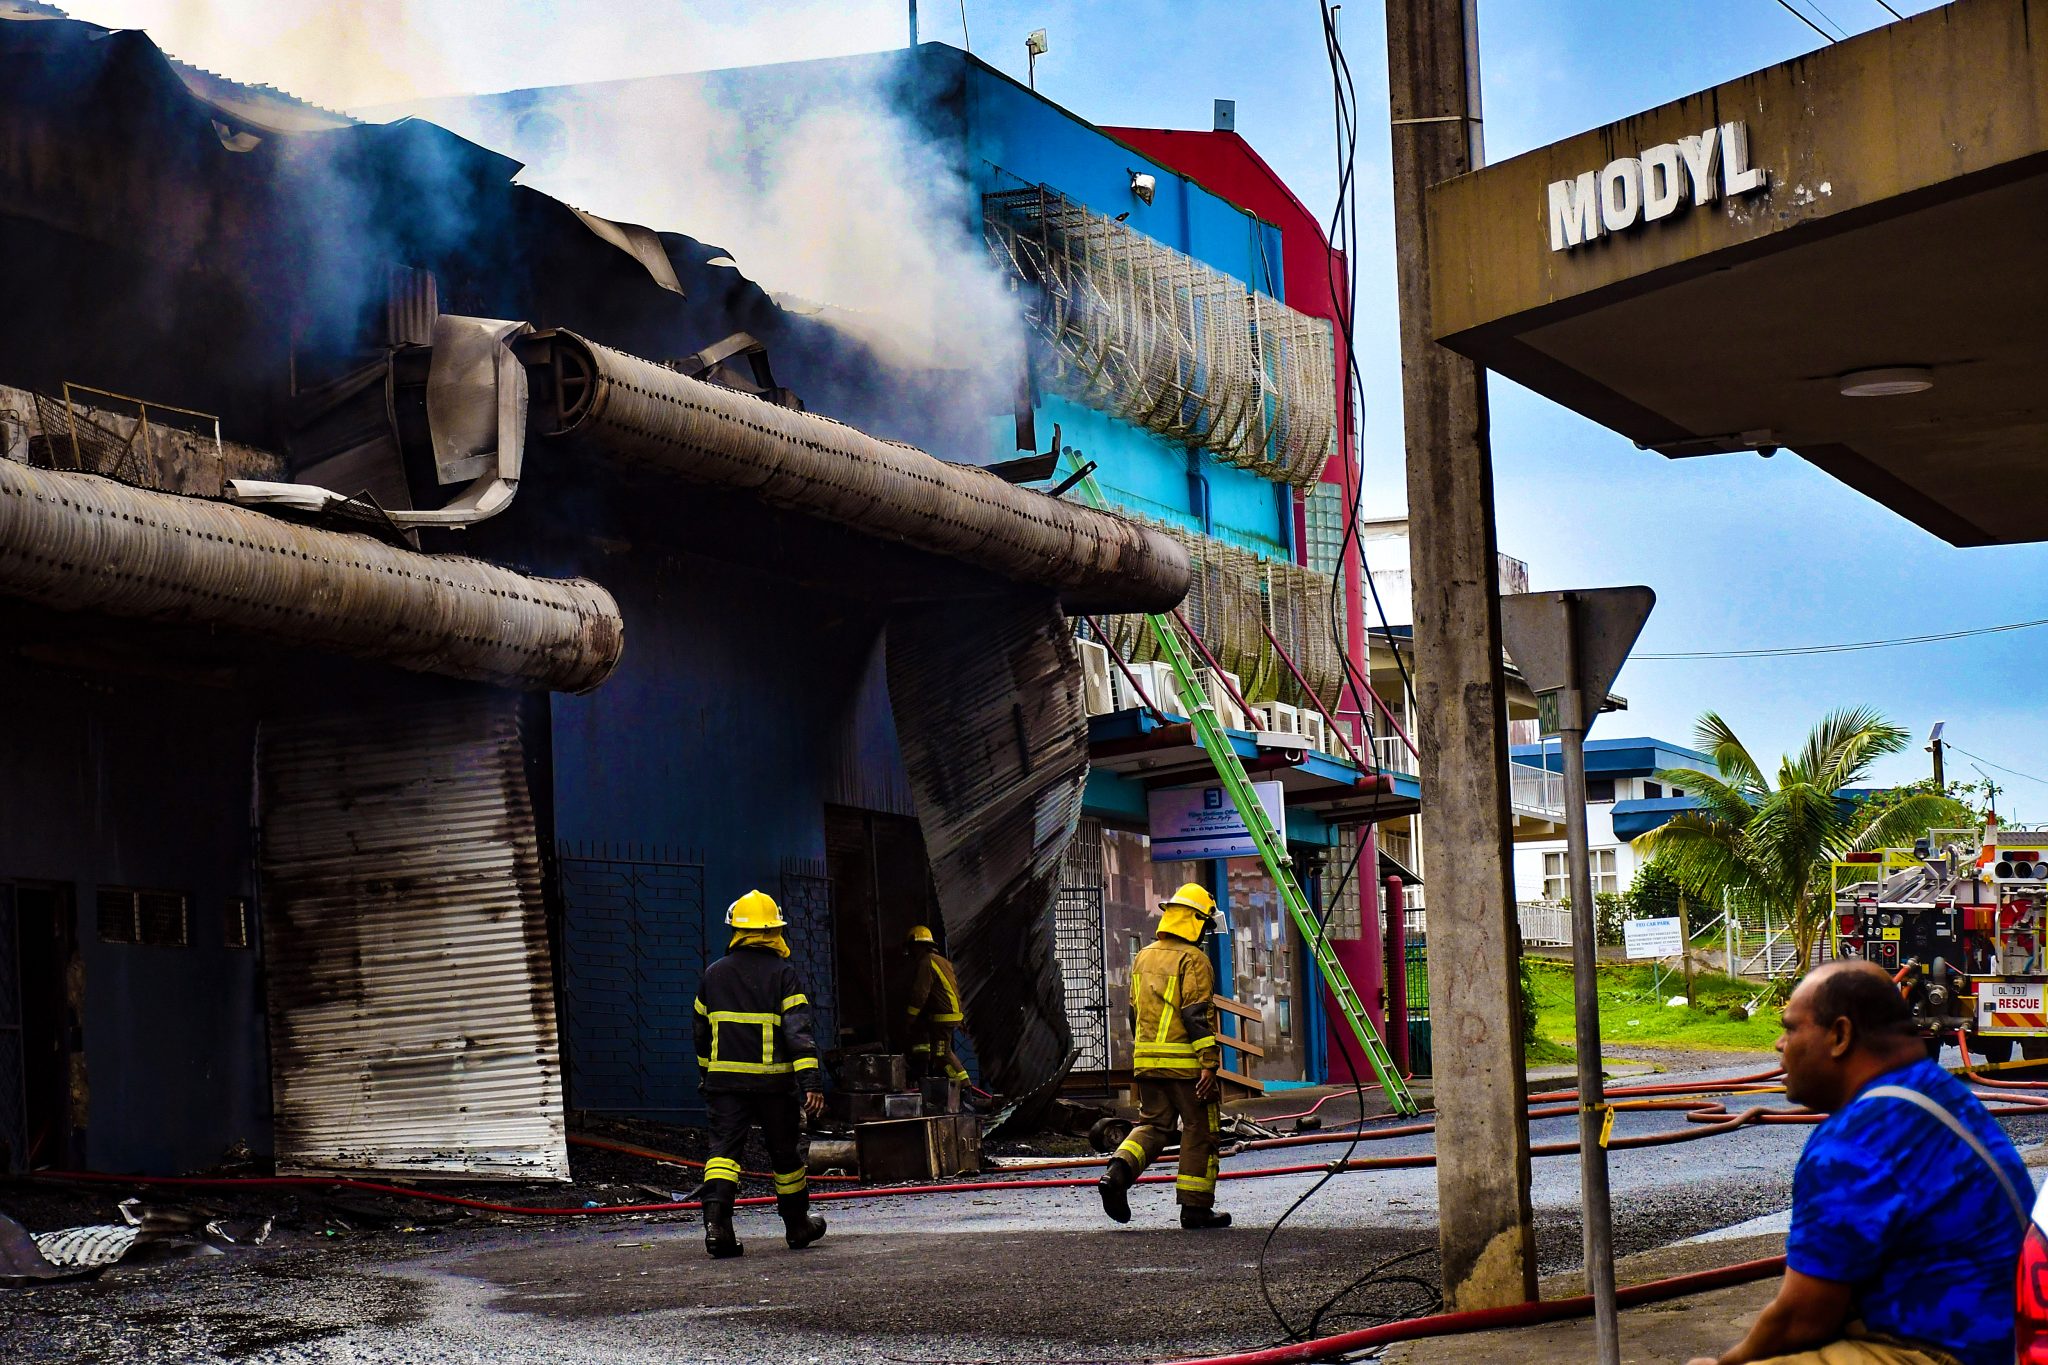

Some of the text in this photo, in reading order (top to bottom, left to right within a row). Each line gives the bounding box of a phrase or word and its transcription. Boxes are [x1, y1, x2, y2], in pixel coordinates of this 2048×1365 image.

[1548, 120, 1766, 252] MODYL
[1538, 694, 1559, 732] HIGH
[2012, 986, 2026, 994] 737
[1998, 998, 2040, 1008] RESCUE
